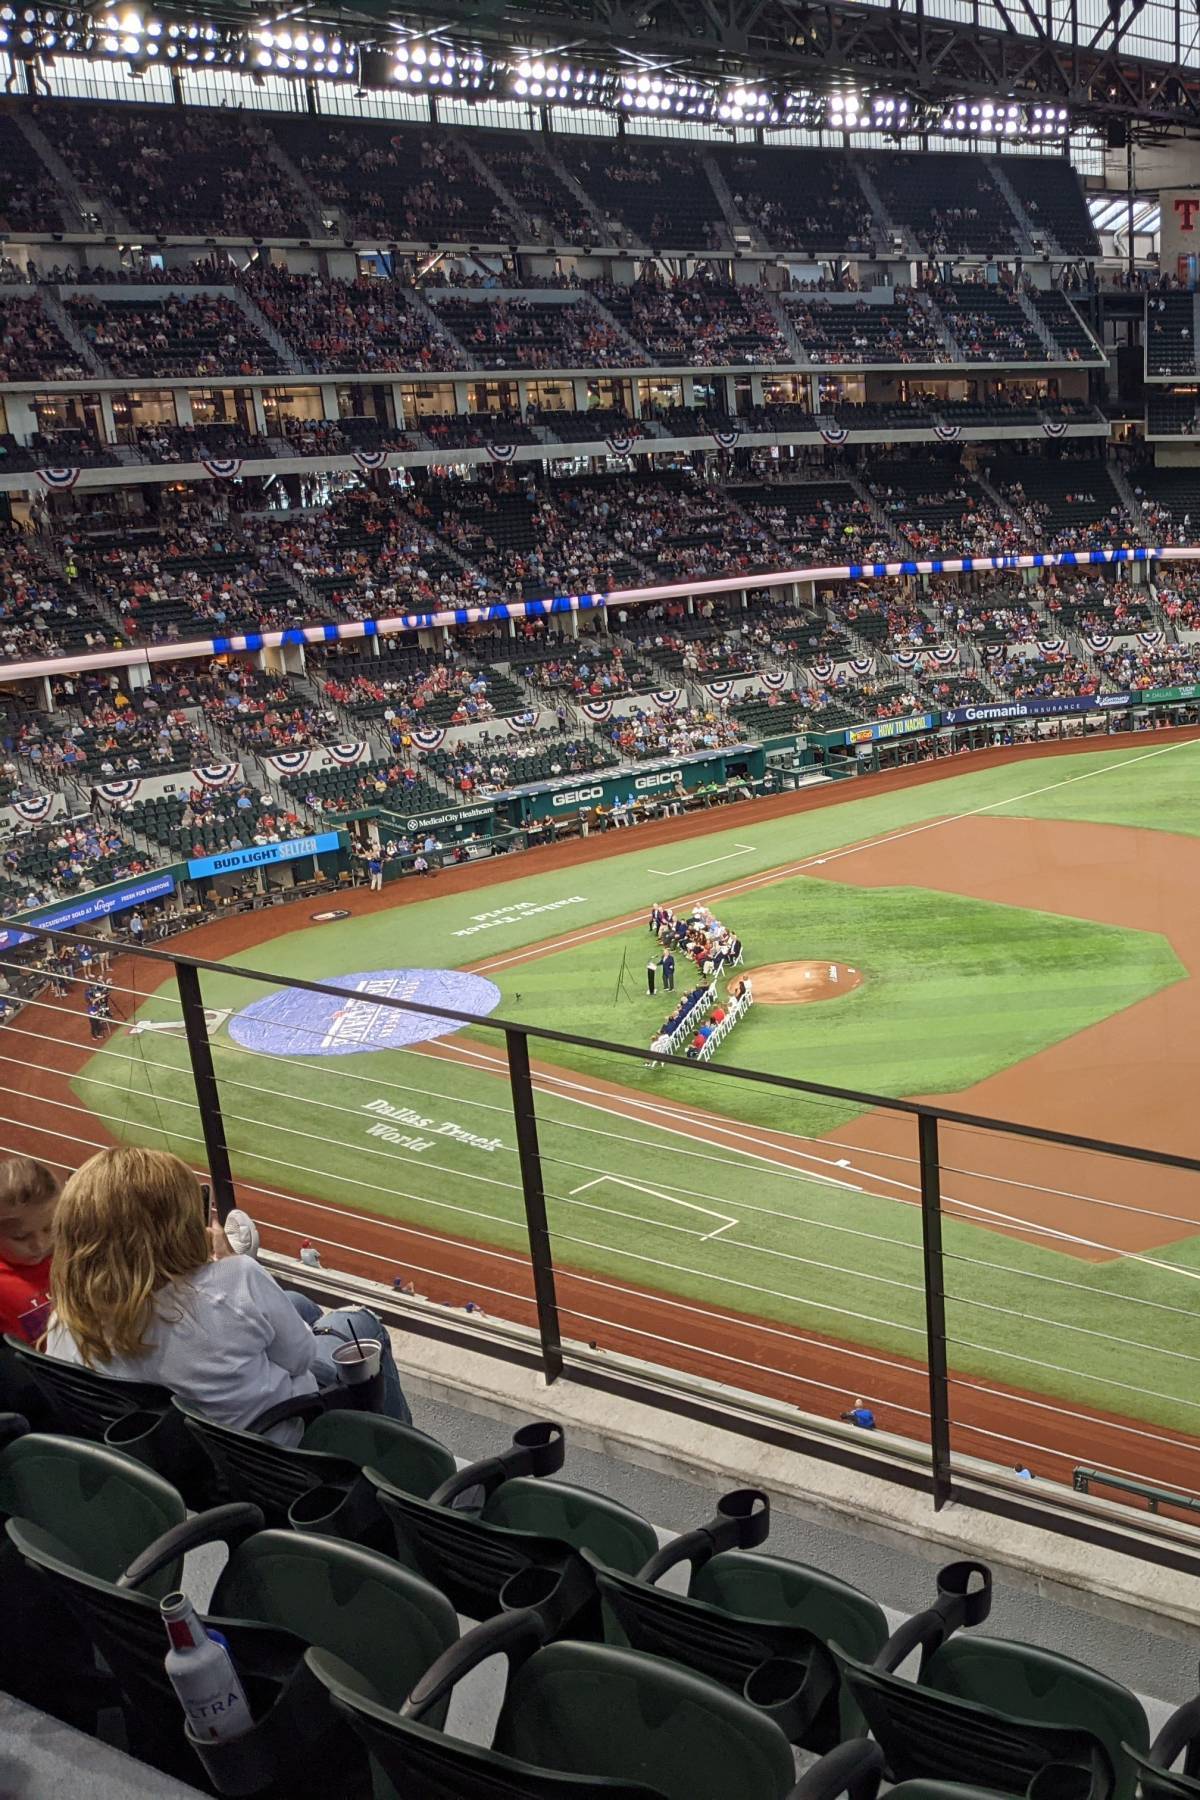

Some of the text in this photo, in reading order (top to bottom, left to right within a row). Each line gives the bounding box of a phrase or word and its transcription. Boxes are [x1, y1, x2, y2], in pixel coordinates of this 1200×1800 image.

[1174, 199, 1200, 231] T
[965, 703, 1081, 720] Germania INSURANCE
[878, 722, 894, 737] HOW
[895, 720, 904, 734] TO
[635, 770, 683, 790] GEICO
[552, 786, 604, 807] GEICO
[419, 815, 445, 828] Medical
[445, 813, 459, 822] City
[459, 807, 495, 819] Healthcare
[213, 838, 317, 870] BUD LIGHT SELTZER
[94, 900, 116, 912] Kroger
[450, 895, 588, 937] Dallas Truck
[469, 901, 538, 921] World
[361, 1098, 504, 1152] Dallas Truck
[365, 1122, 437, 1152] World
